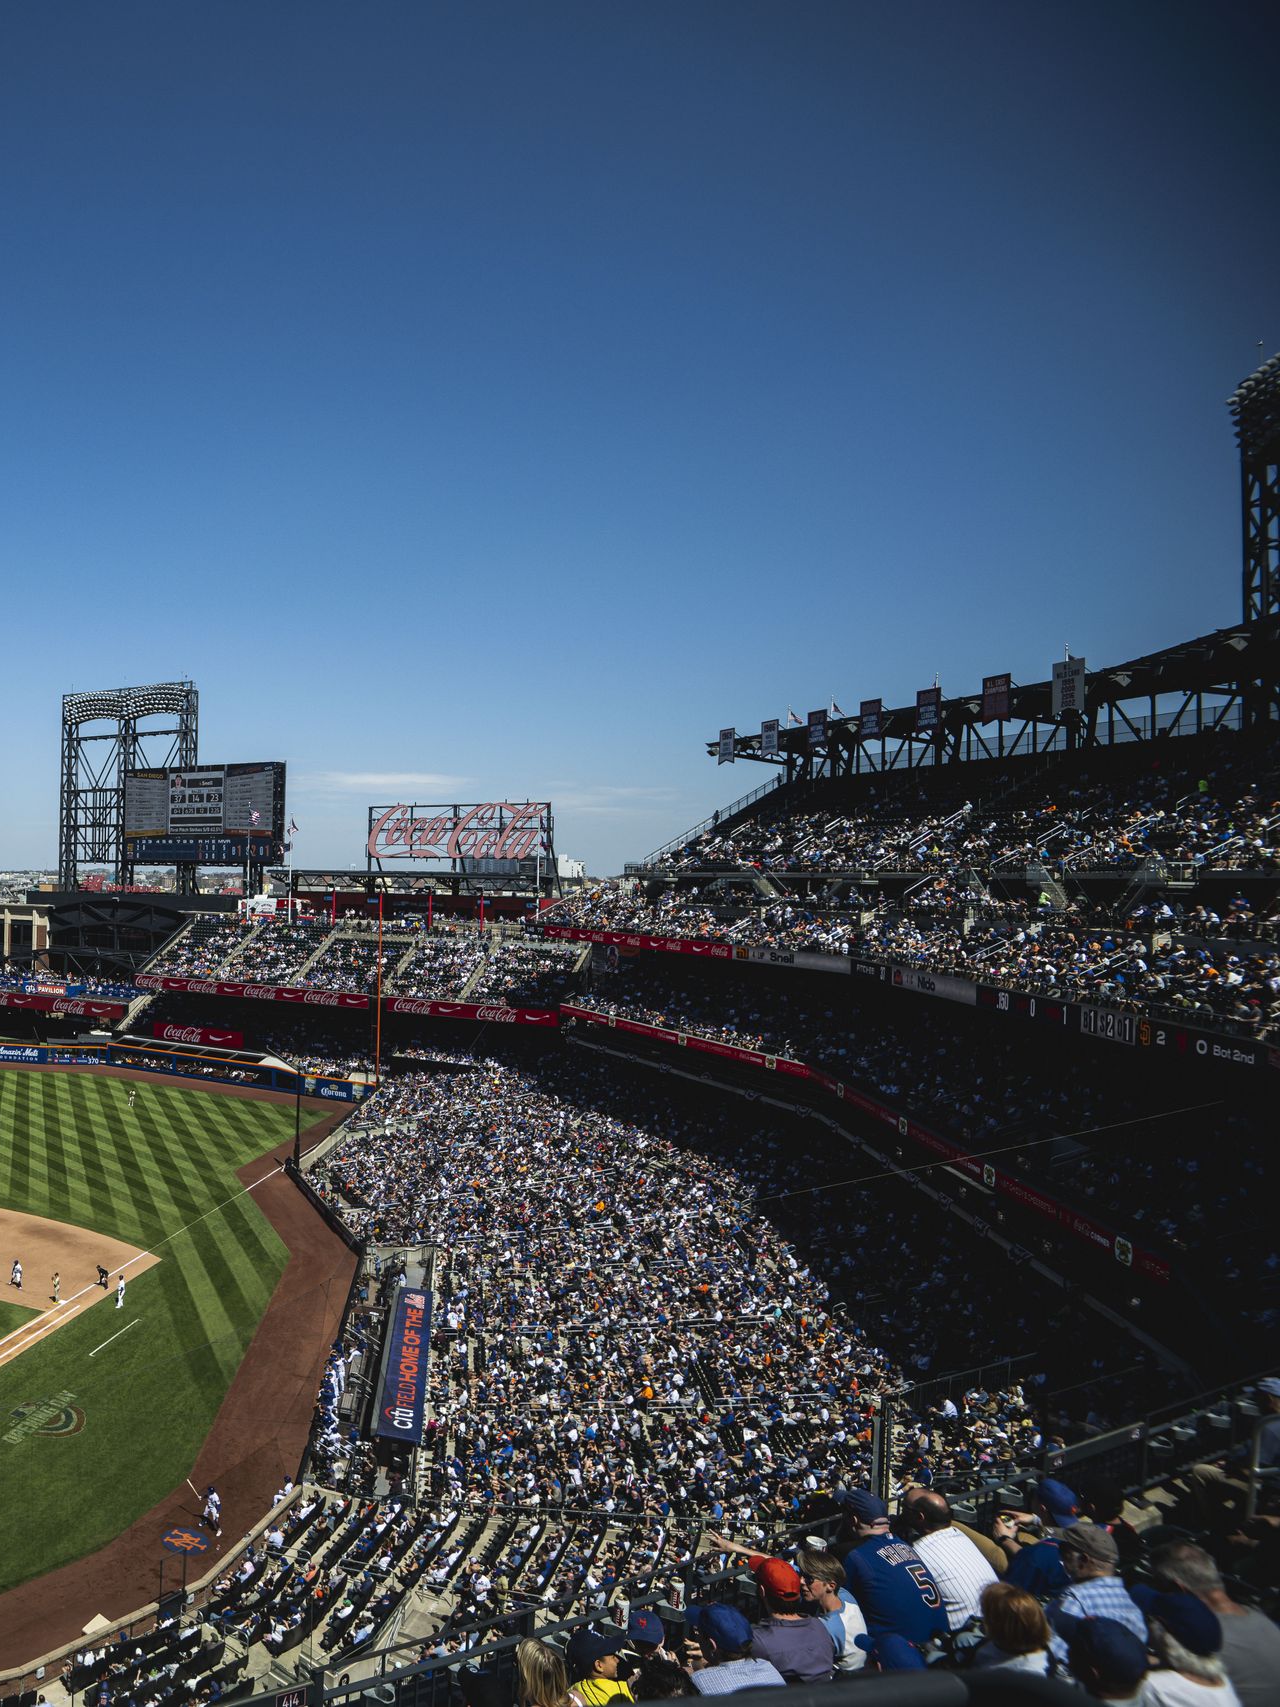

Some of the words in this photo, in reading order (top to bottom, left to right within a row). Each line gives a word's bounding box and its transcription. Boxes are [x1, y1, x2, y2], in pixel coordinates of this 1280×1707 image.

[174, 794, 183, 803] 37
[192, 794, 200, 802] 14
[210, 794, 219, 802] 23
[368, 802, 550, 859] Coca-Cola
[769, 952, 795, 964] Snell
[37, 985, 65, 996] PAVILION
[135, 975, 163, 990] Coca-Cola
[187, 979, 218, 994] Coca-Cola
[917, 975, 936, 992] Nido
[243, 984, 276, 1000] Coca-Cola
[303, 991, 340, 1006] Coca-Cola
[52, 998, 85, 1015] Coca-Cola
[393, 999, 433, 1015] Coca-Cola
[476, 1006, 517, 1023] Coca-Cola
[1062, 1005, 1067, 1025] 1
[1089, 1010, 1095, 1032] 1
[1106, 1014, 1114, 1036] 2
[1124, 1017, 1130, 1040] 1
[163, 1024, 203, 1043] Coca-Cola
[1156, 1030, 1166, 1045] 2
[22, 1048, 39, 1057] Mets
[1212, 1044, 1232, 1059] Bot
[1232, 1049, 1255, 1065] 2nd
[87, 1057, 99, 1065] 370
[321, 1087, 347, 1098] Corona
[405, 1307, 424, 1328] THE
[403, 1330, 422, 1345] OF
[399, 1345, 420, 1383] HOME
[396, 1384, 416, 1409] FIELD
[384, 1405, 414, 1430] citi
[905, 1563, 941, 1608] 5
[282, 1692, 300, 1707] 414
